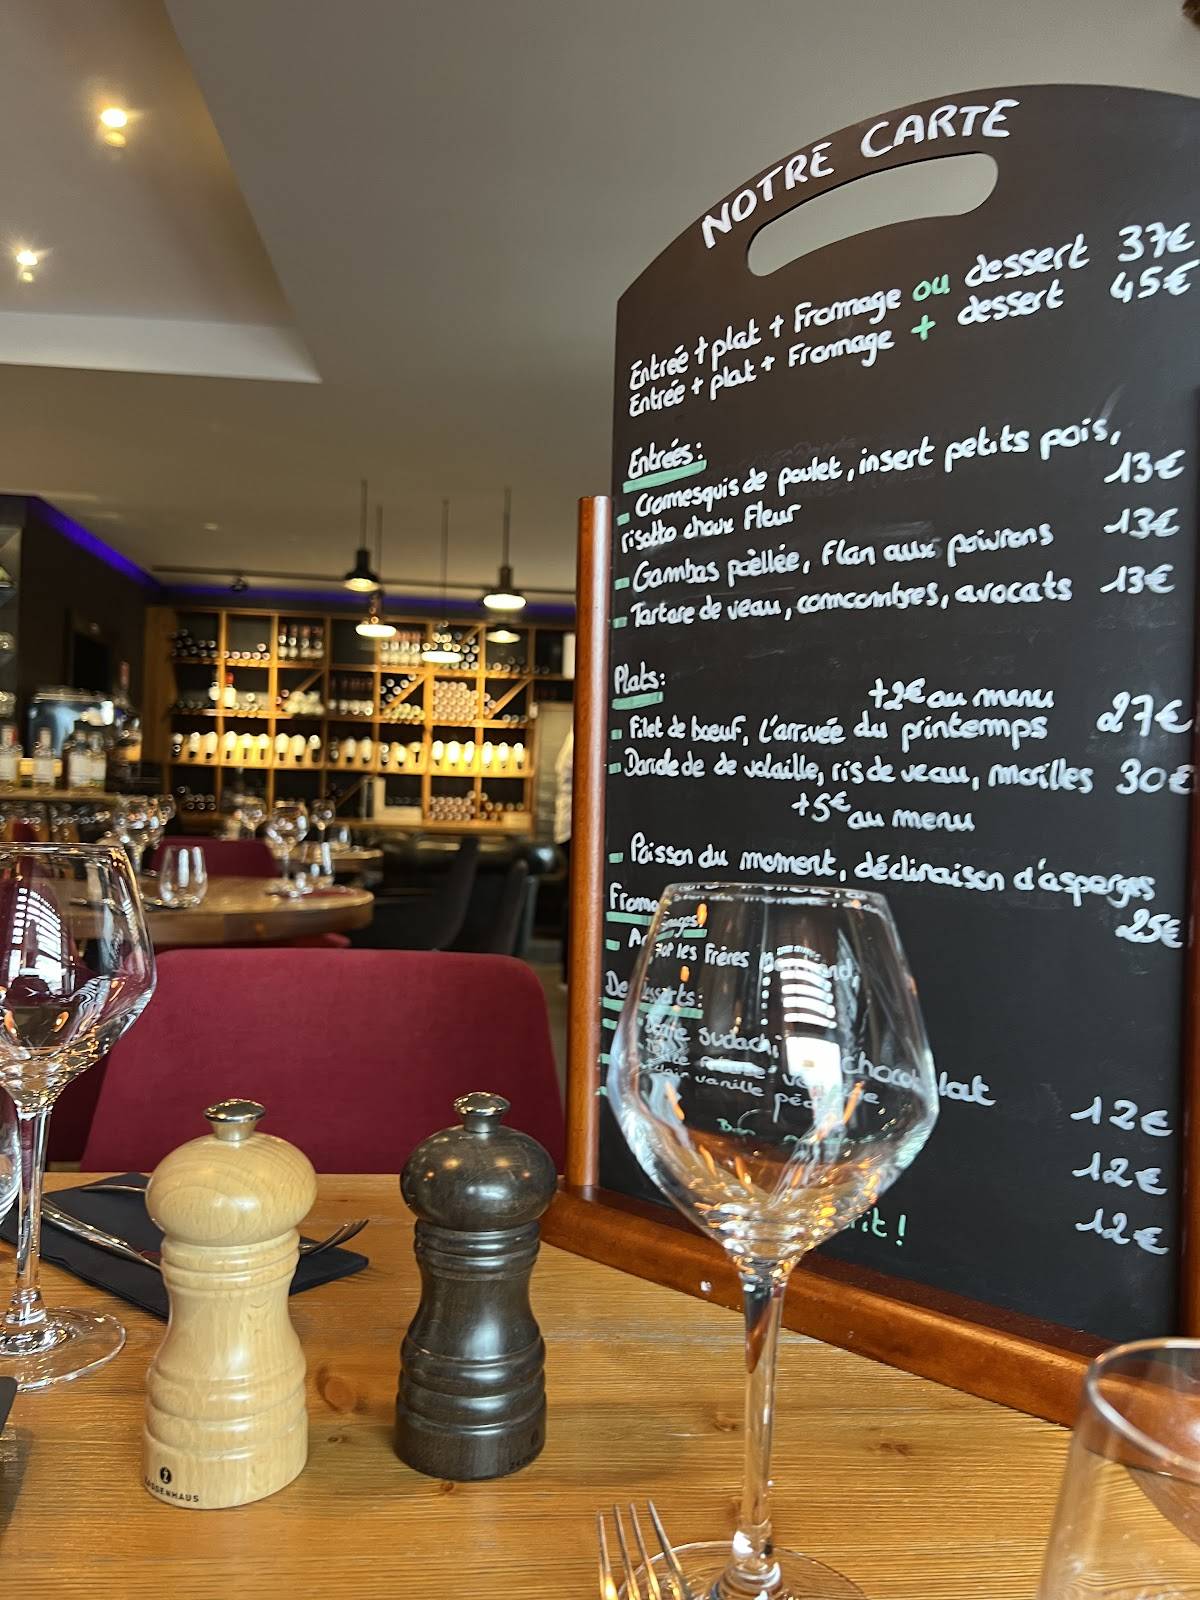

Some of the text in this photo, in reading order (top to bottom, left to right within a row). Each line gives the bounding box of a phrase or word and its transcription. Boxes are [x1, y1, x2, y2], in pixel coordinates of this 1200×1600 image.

[701, 99, 1019, 249] NOTRE CARTE
[629, 345, 689, 390] Entrée
[712, 322, 761, 372] plat
[794, 289, 901, 336] Fromage
[912, 274, 950, 301] ou
[964, 233, 1090, 287] dessert
[1117, 222, 1195, 261] 37€
[629, 379, 685, 417] Entrée
[710, 359, 757, 400] plat
[788, 330, 896, 367] Fromage
[957, 279, 1064, 326] dessert
[1109, 259, 1200, 303] 45€
[742, 468, 768, 494] de
[859, 436, 936, 474] insert
[944, 425, 1029, 473] petits
[1103, 450, 1186, 484] 13€
[621, 519, 677, 553] risotto
[743, 500, 801, 530] Fleur
[632, 558, 720, 593] Gambas
[821, 539, 876, 566] Flan
[883, 541, 936, 562] aux
[948, 523, 1055, 568] poivrons
[1103, 507, 1180, 539] 13€
[630, 600, 694, 627] Tartare
[700, 594, 722, 621] de
[955, 571, 1072, 605] avocats
[1100, 564, 1176, 595] 13€
[614, 661, 665, 695] Plats:
[926, 689, 968, 709] au
[972, 688, 1055, 709] menu
[629, 714, 664, 740] Filet
[667, 714, 686, 740] de
[853, 710, 888, 739] du
[901, 711, 1048, 753] printemps
[1096, 691, 1192, 737] 27€
[682, 751, 705, 778] de
[714, 752, 737, 776] de
[832, 760, 864, 784] ris
[867, 755, 896, 783] de
[988, 758, 1094, 793] morilles
[1115, 758, 1194, 794] 30€
[848, 812, 885, 830] au
[892, 808, 976, 832] menu
[631, 832, 693, 866] Poisson
[700, 844, 728, 868] du
[854, 851, 1005, 891] déclinaison
[1115, 908, 1183, 948] 25€
[695, 1074, 764, 1097] vanille
[1070, 1096, 1173, 1137] 12€
[1071, 1151, 1168, 1195] 12€
[1075, 1208, 1169, 1255] 12€
